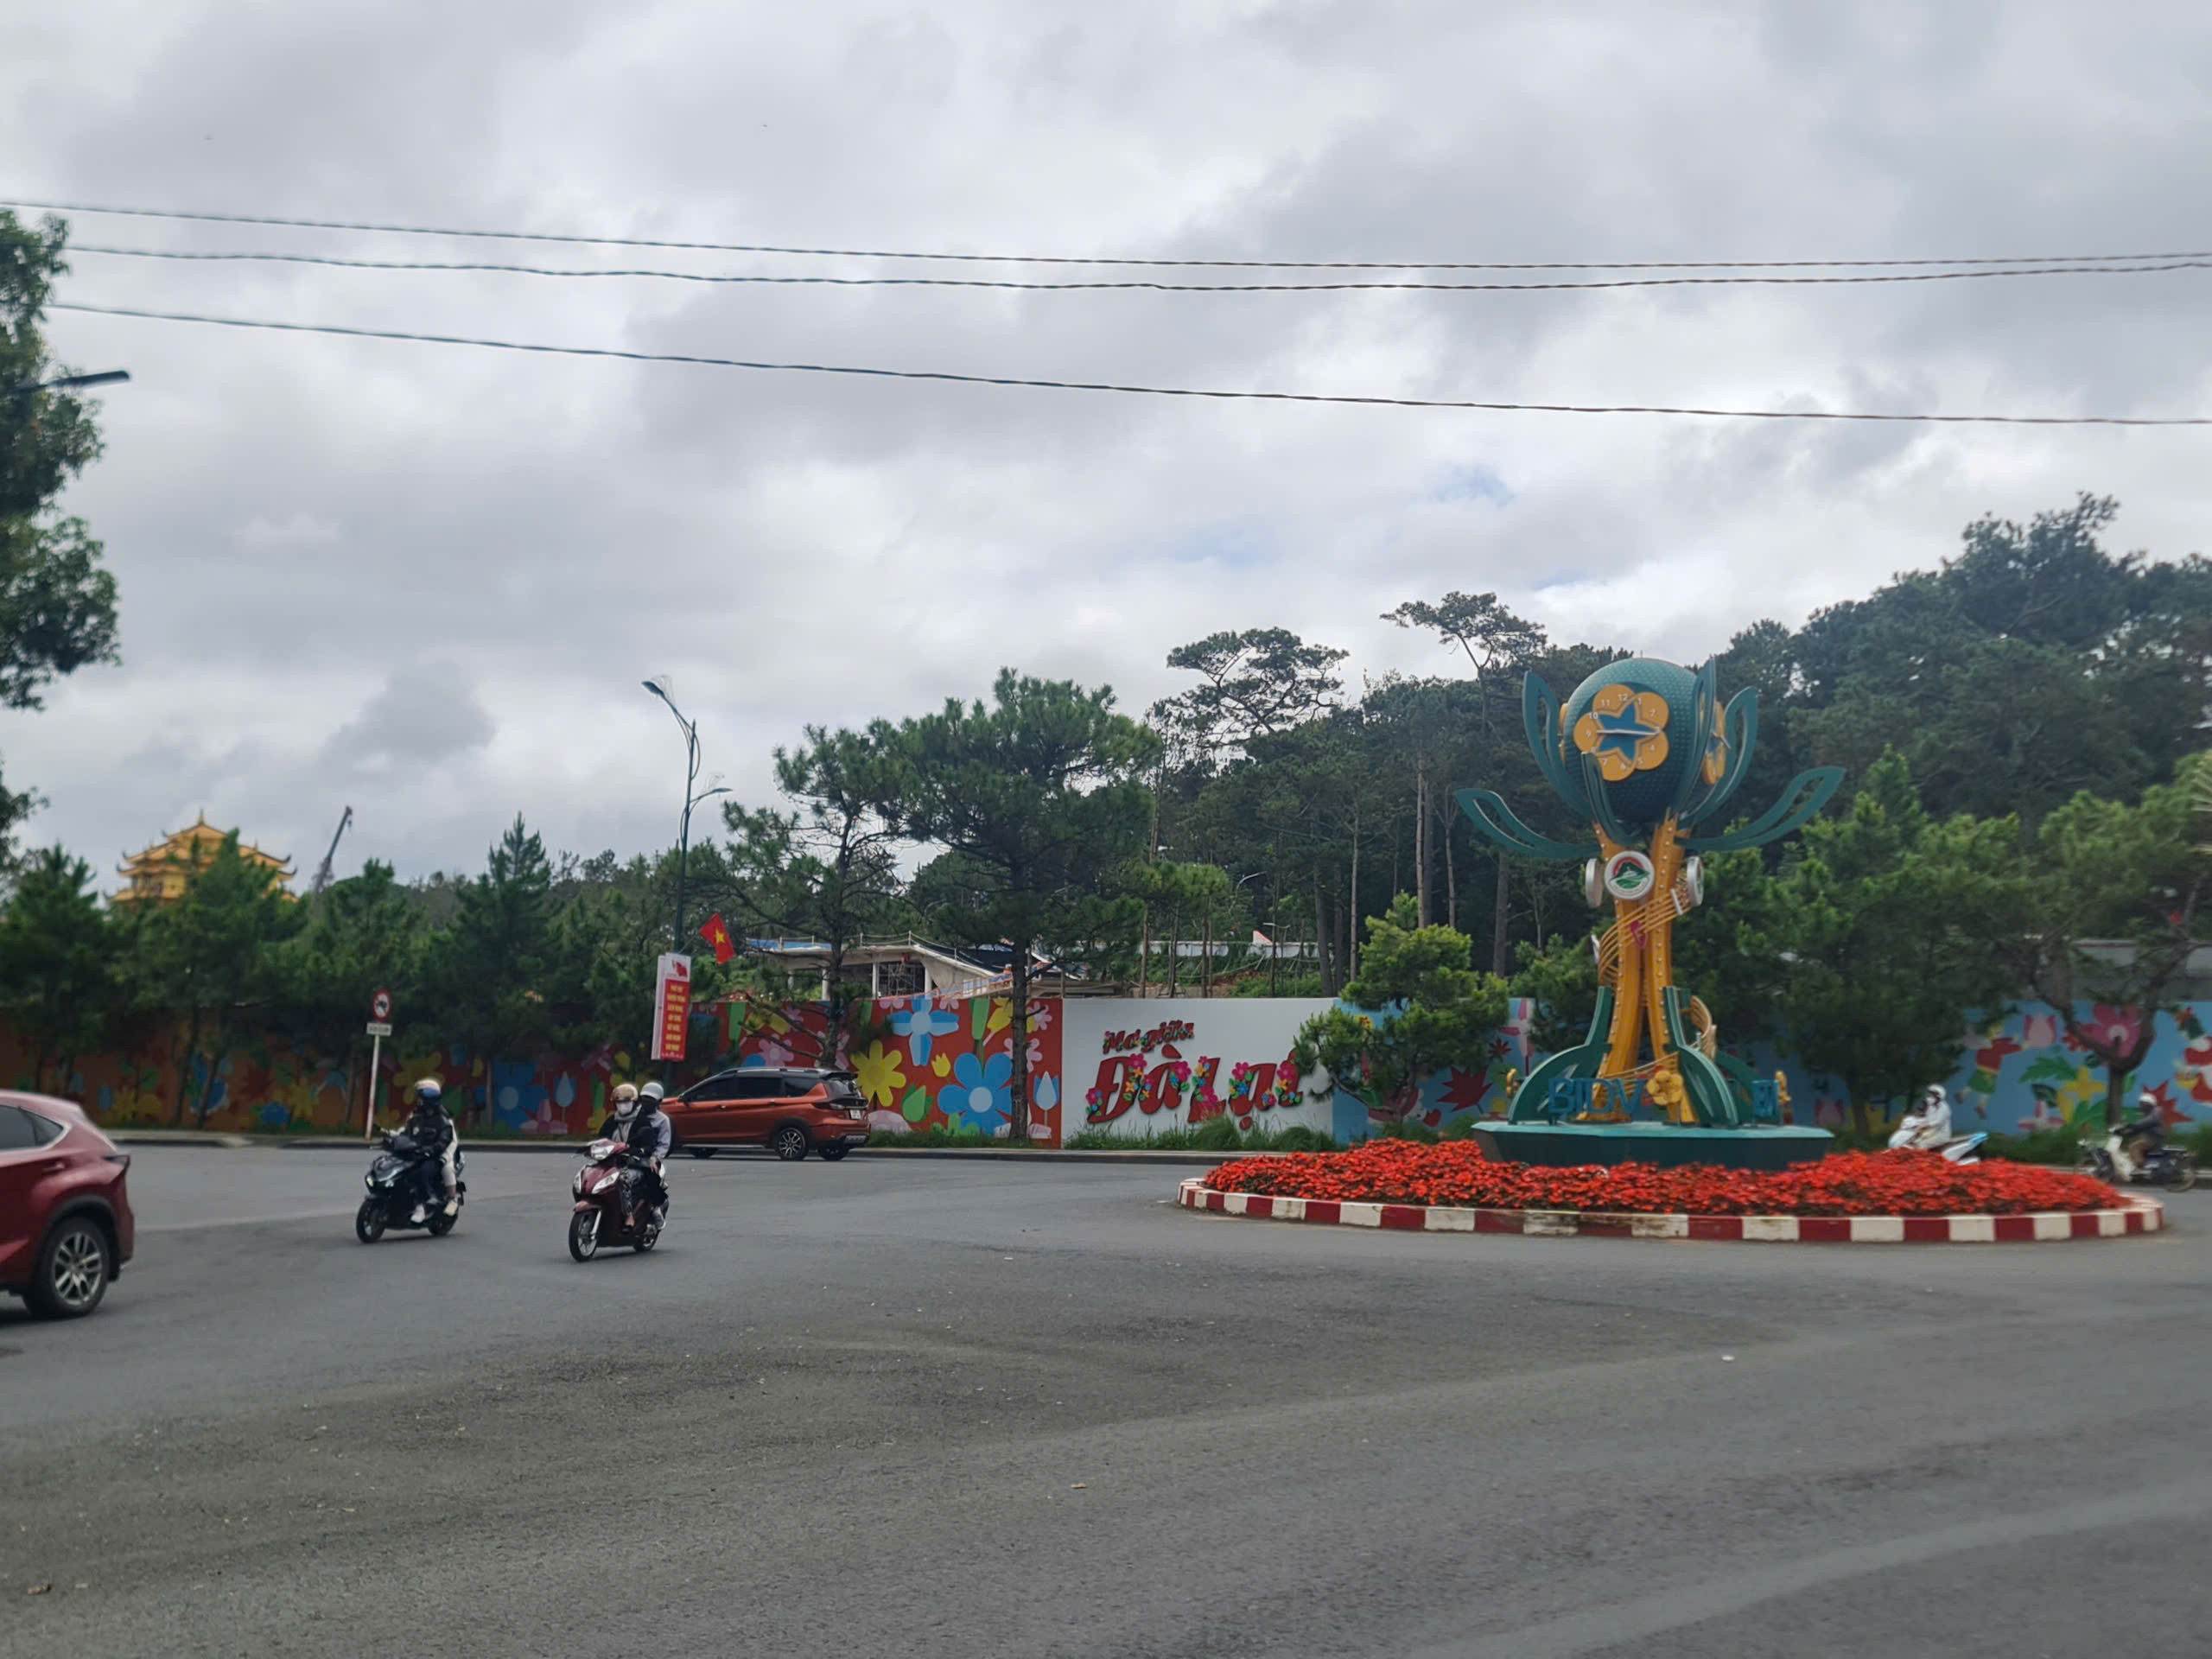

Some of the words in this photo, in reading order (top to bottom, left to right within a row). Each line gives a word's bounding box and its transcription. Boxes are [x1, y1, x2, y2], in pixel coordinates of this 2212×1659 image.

[1618, 693, 1628, 702] 12
[1637, 697, 1643, 706] 1
[1085, 1044, 1192, 1123] Đà
[1548, 1077, 1643, 1115] BIDV
